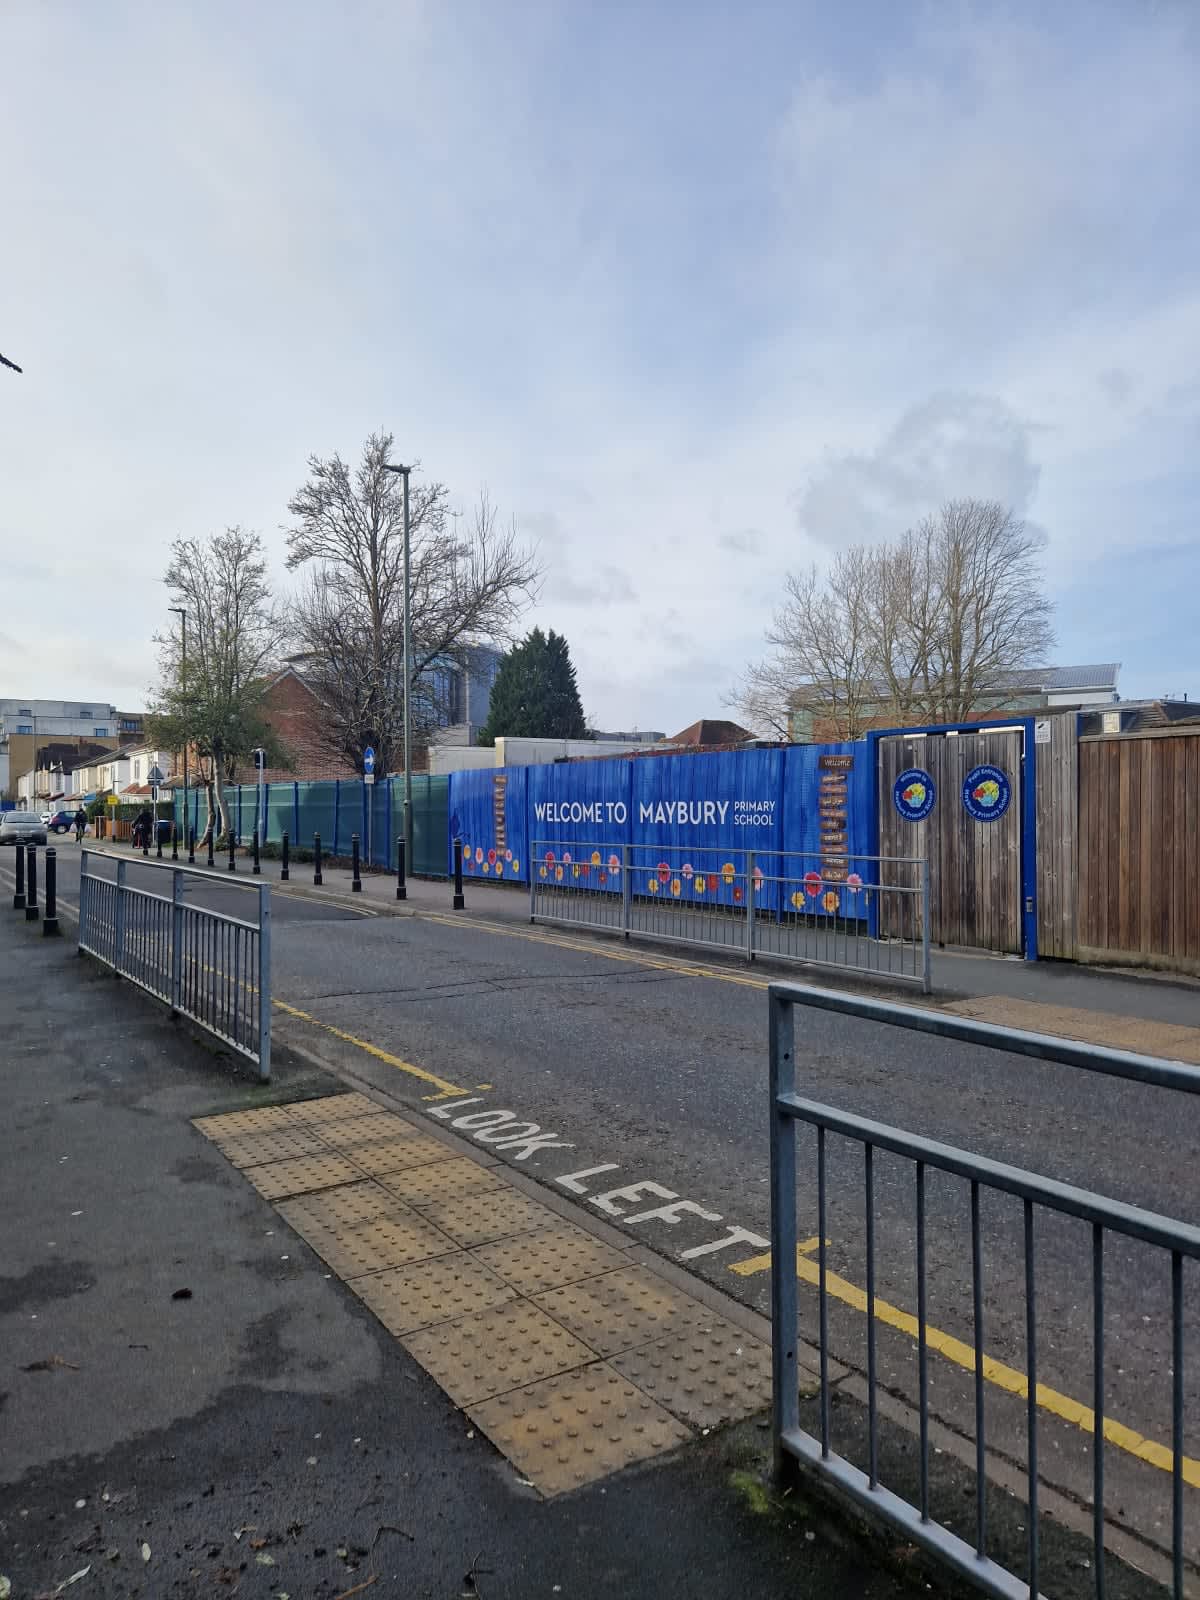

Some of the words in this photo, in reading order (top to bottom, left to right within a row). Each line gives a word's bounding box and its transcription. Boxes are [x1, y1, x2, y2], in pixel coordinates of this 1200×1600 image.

[981, 768, 1004, 783] Entrance
[534, 801, 603, 823] WELCOME
[606, 801, 627, 824] TO
[639, 800, 730, 825] MAYBURY
[734, 800, 776, 812] PRIMARY
[976, 809, 1000, 819] Primary
[998, 787, 1008, 809] School
[734, 814, 774, 826] SCHOOL
[906, 810, 927, 819] Primary
[426, 1097, 577, 1161] LOOK
[555, 1163, 772, 1260] LEFT
